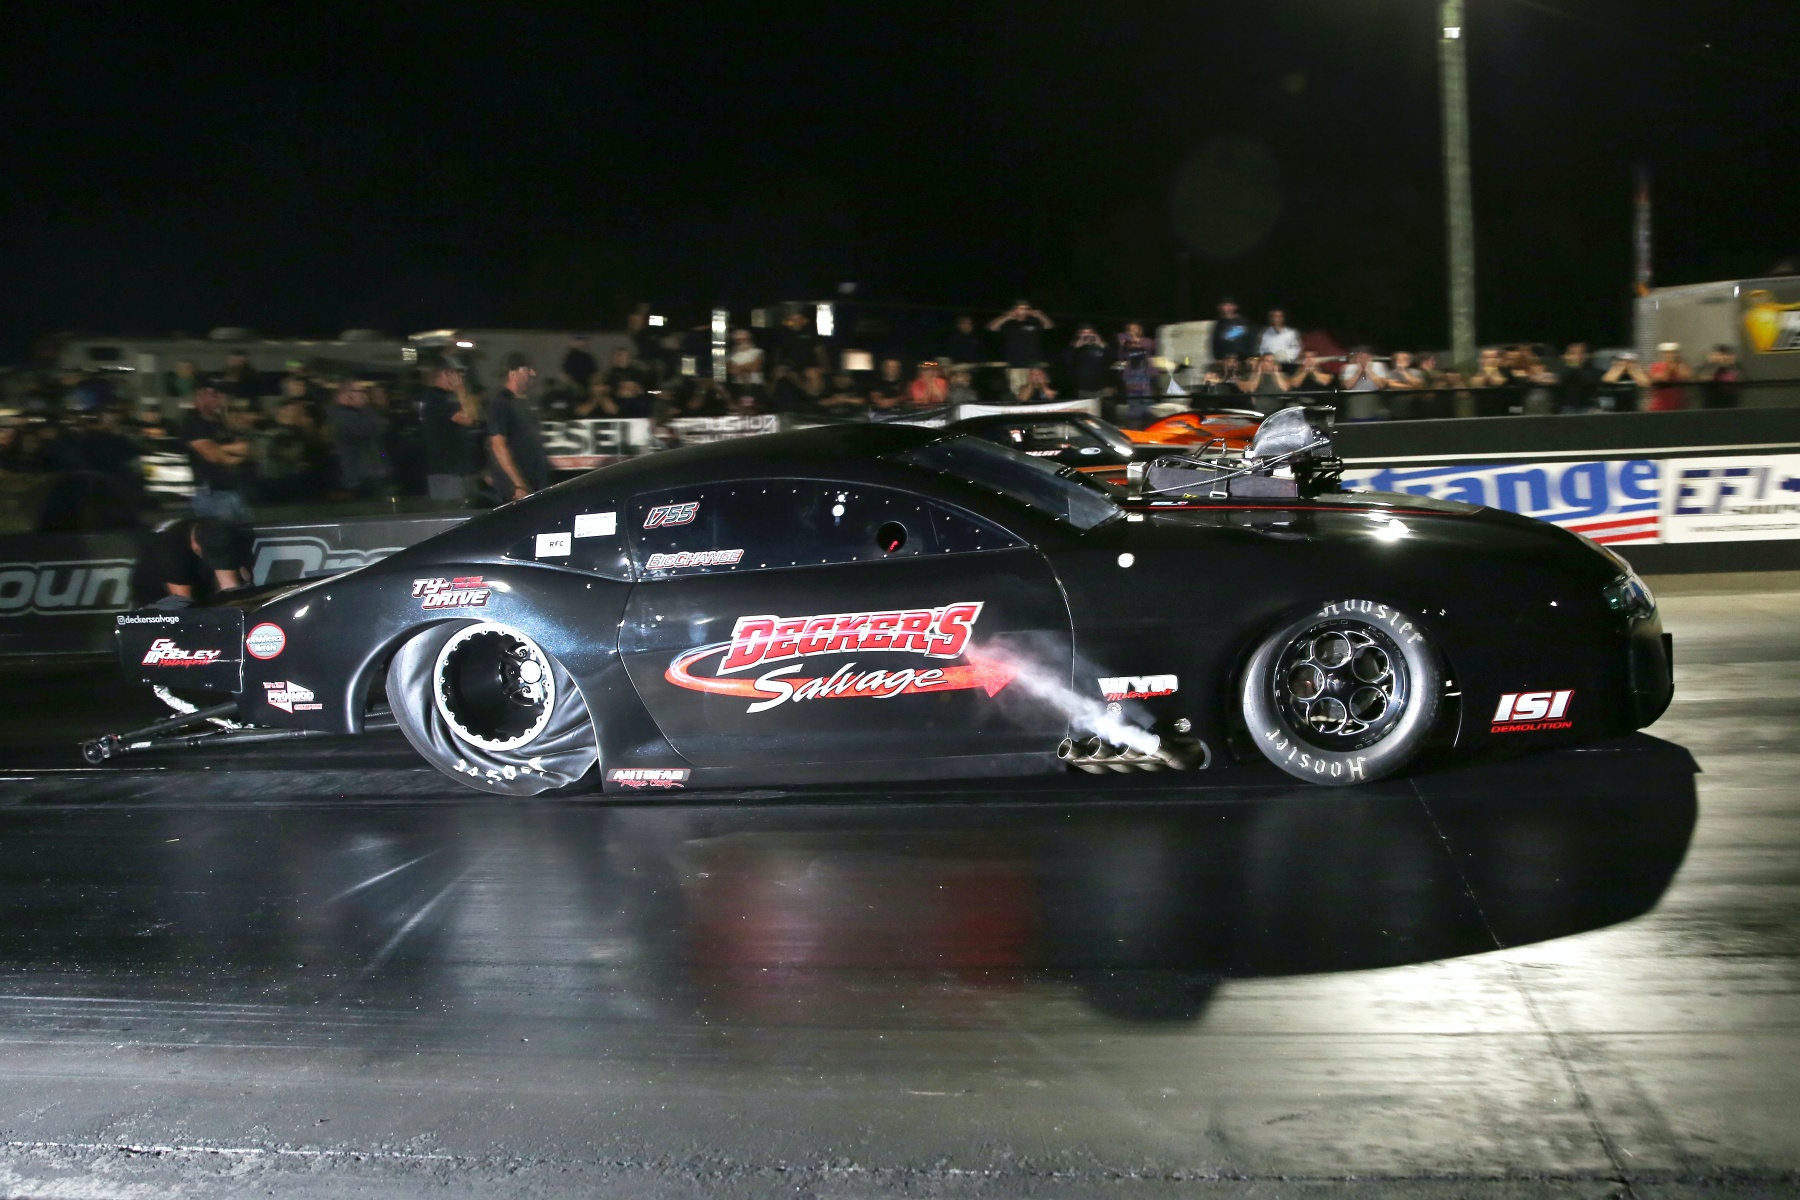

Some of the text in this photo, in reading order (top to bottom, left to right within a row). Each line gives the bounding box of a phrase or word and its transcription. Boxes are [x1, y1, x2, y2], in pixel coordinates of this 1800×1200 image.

[644, 502, 700, 529] 1755
[421, 589, 491, 611] DRIVE
[125, 615, 179, 624] deckerssalvage
[716, 601, 984, 676] DECKER'S
[142, 648, 221, 665] MOBLEY
[746, 661, 948, 713] Salvage
[1492, 690, 1575, 724] ISI
[1491, 721, 1573, 733] DEMOLITION
[1265, 729, 1367, 782] Hoosier
